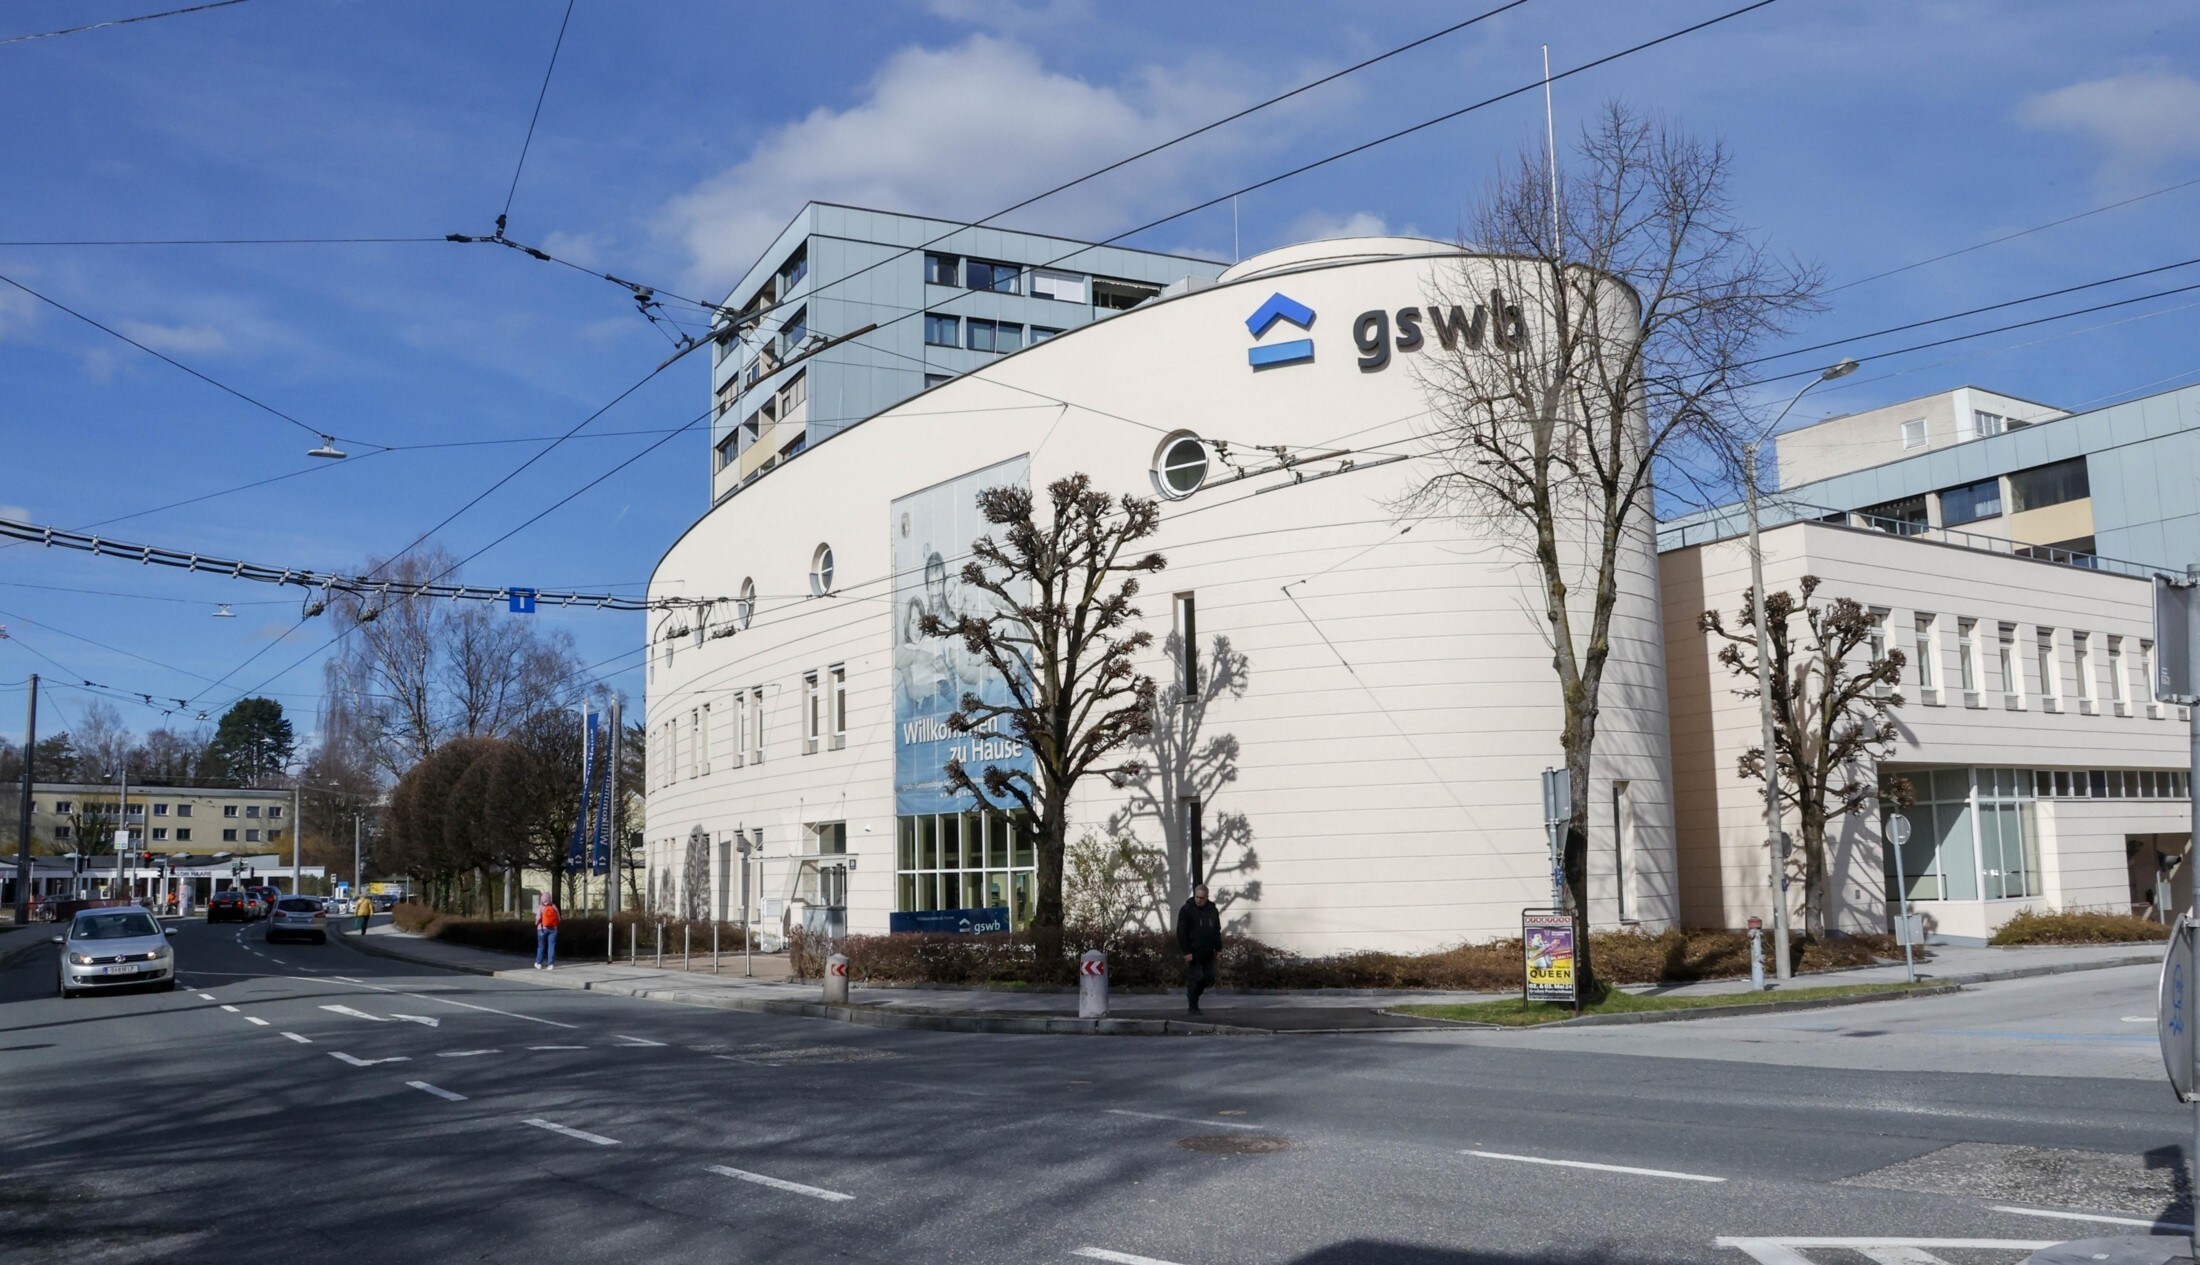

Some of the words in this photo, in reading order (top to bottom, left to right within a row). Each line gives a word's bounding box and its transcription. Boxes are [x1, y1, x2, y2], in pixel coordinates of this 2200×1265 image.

[1353, 288, 1524, 371] gswb
[949, 745, 967, 763] zu
[972, 738, 1023, 761] Hause
[974, 919, 1001, 935] gswb
[1530, 970, 1571, 978] QUEEN
